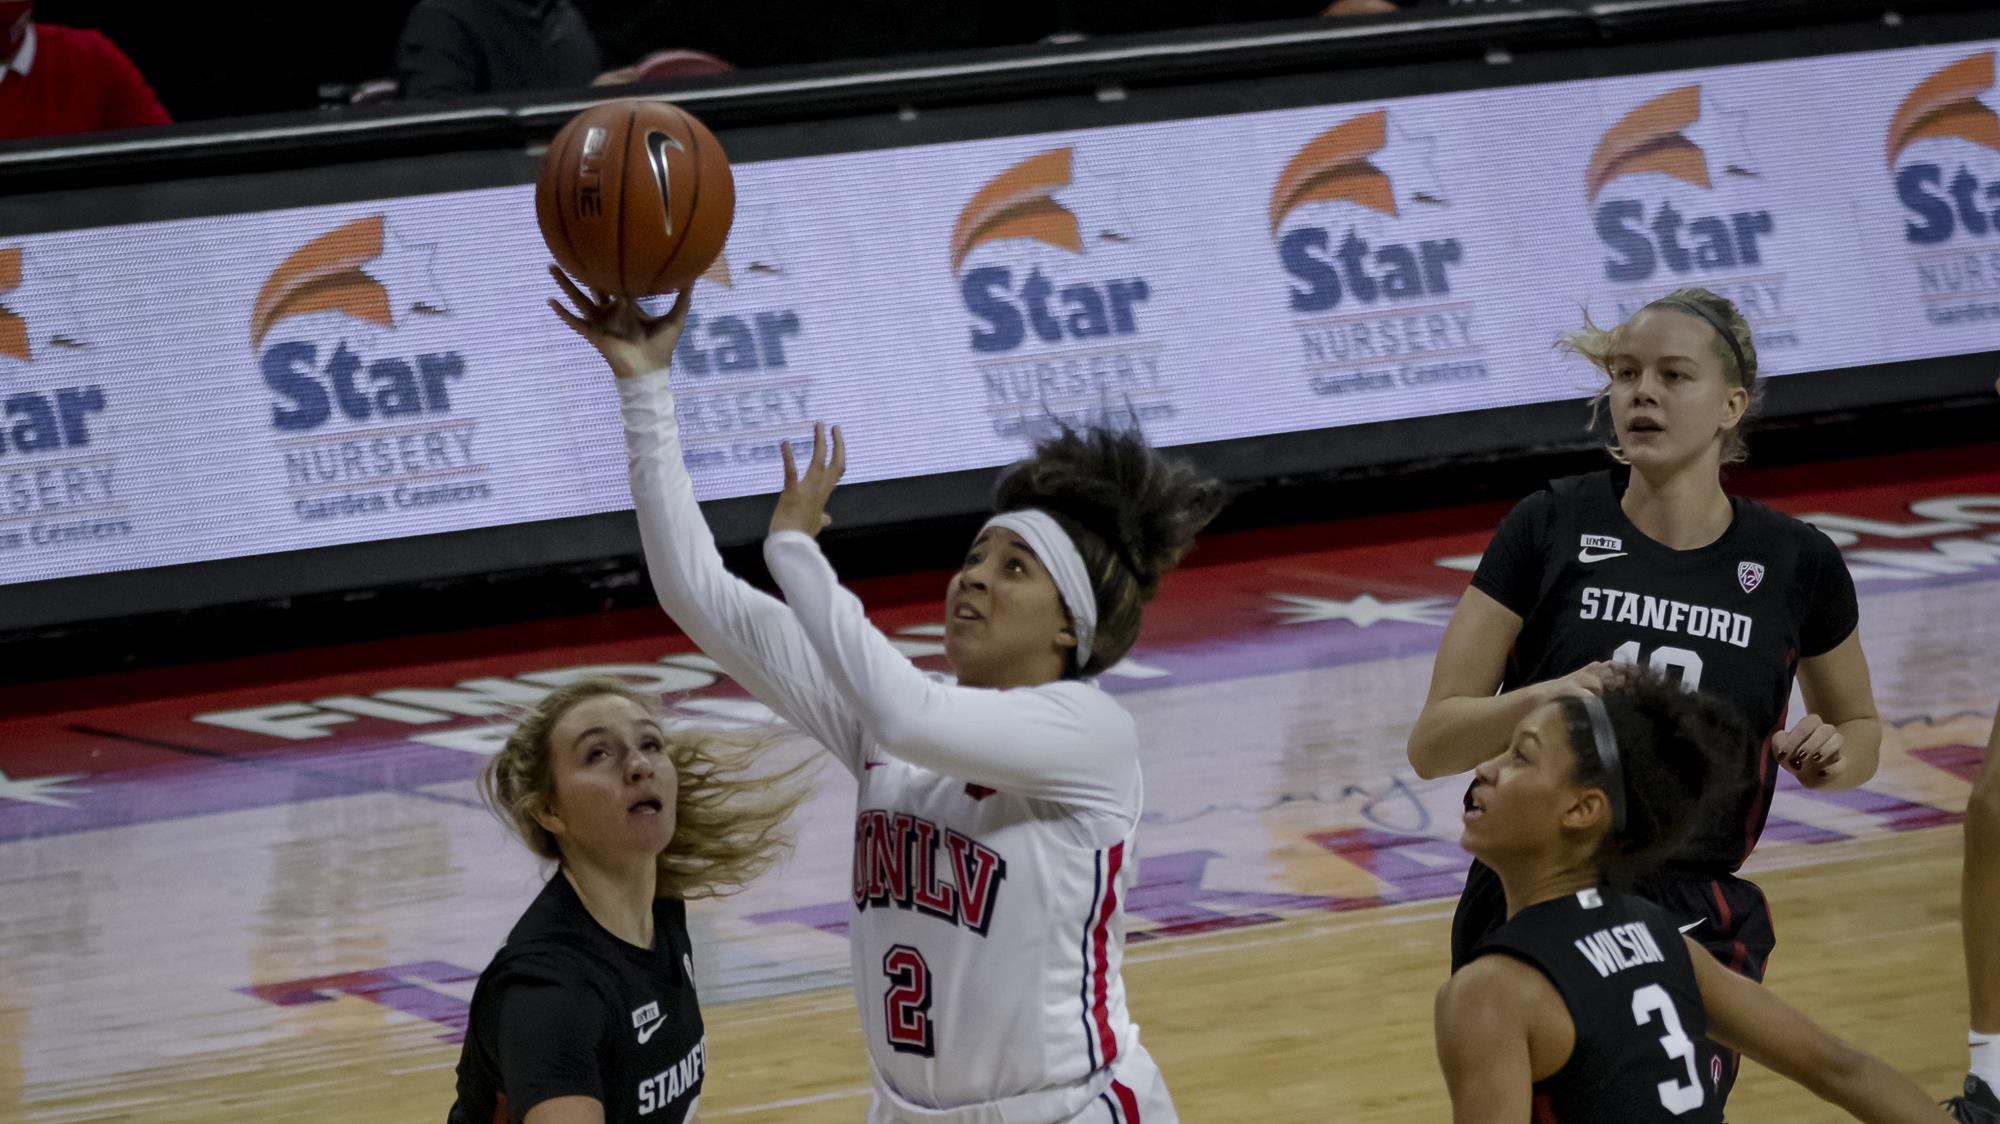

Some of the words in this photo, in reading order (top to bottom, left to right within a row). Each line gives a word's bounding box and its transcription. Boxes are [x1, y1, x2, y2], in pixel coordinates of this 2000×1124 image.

[1279, 227, 1462, 312] Star
[1596, 200, 1774, 281] Star
[676, 309, 801, 376] tar
[962, 265, 1150, 351] Star
[1302, 309, 1473, 361] NURSERY
[261, 340, 465, 432] Star
[982, 355, 1158, 401] NURSERY
[0, 384, 105, 453] ar
[0, 465, 114, 512] SERY
[284, 425, 475, 484] NURSERY
[1580, 587, 1752, 648] STANFORD
[853, 810, 1007, 938] UNLV
[1574, 921, 1665, 978] WILSON
[883, 944, 935, 1058] 2
[1632, 983, 1704, 1116] 3
